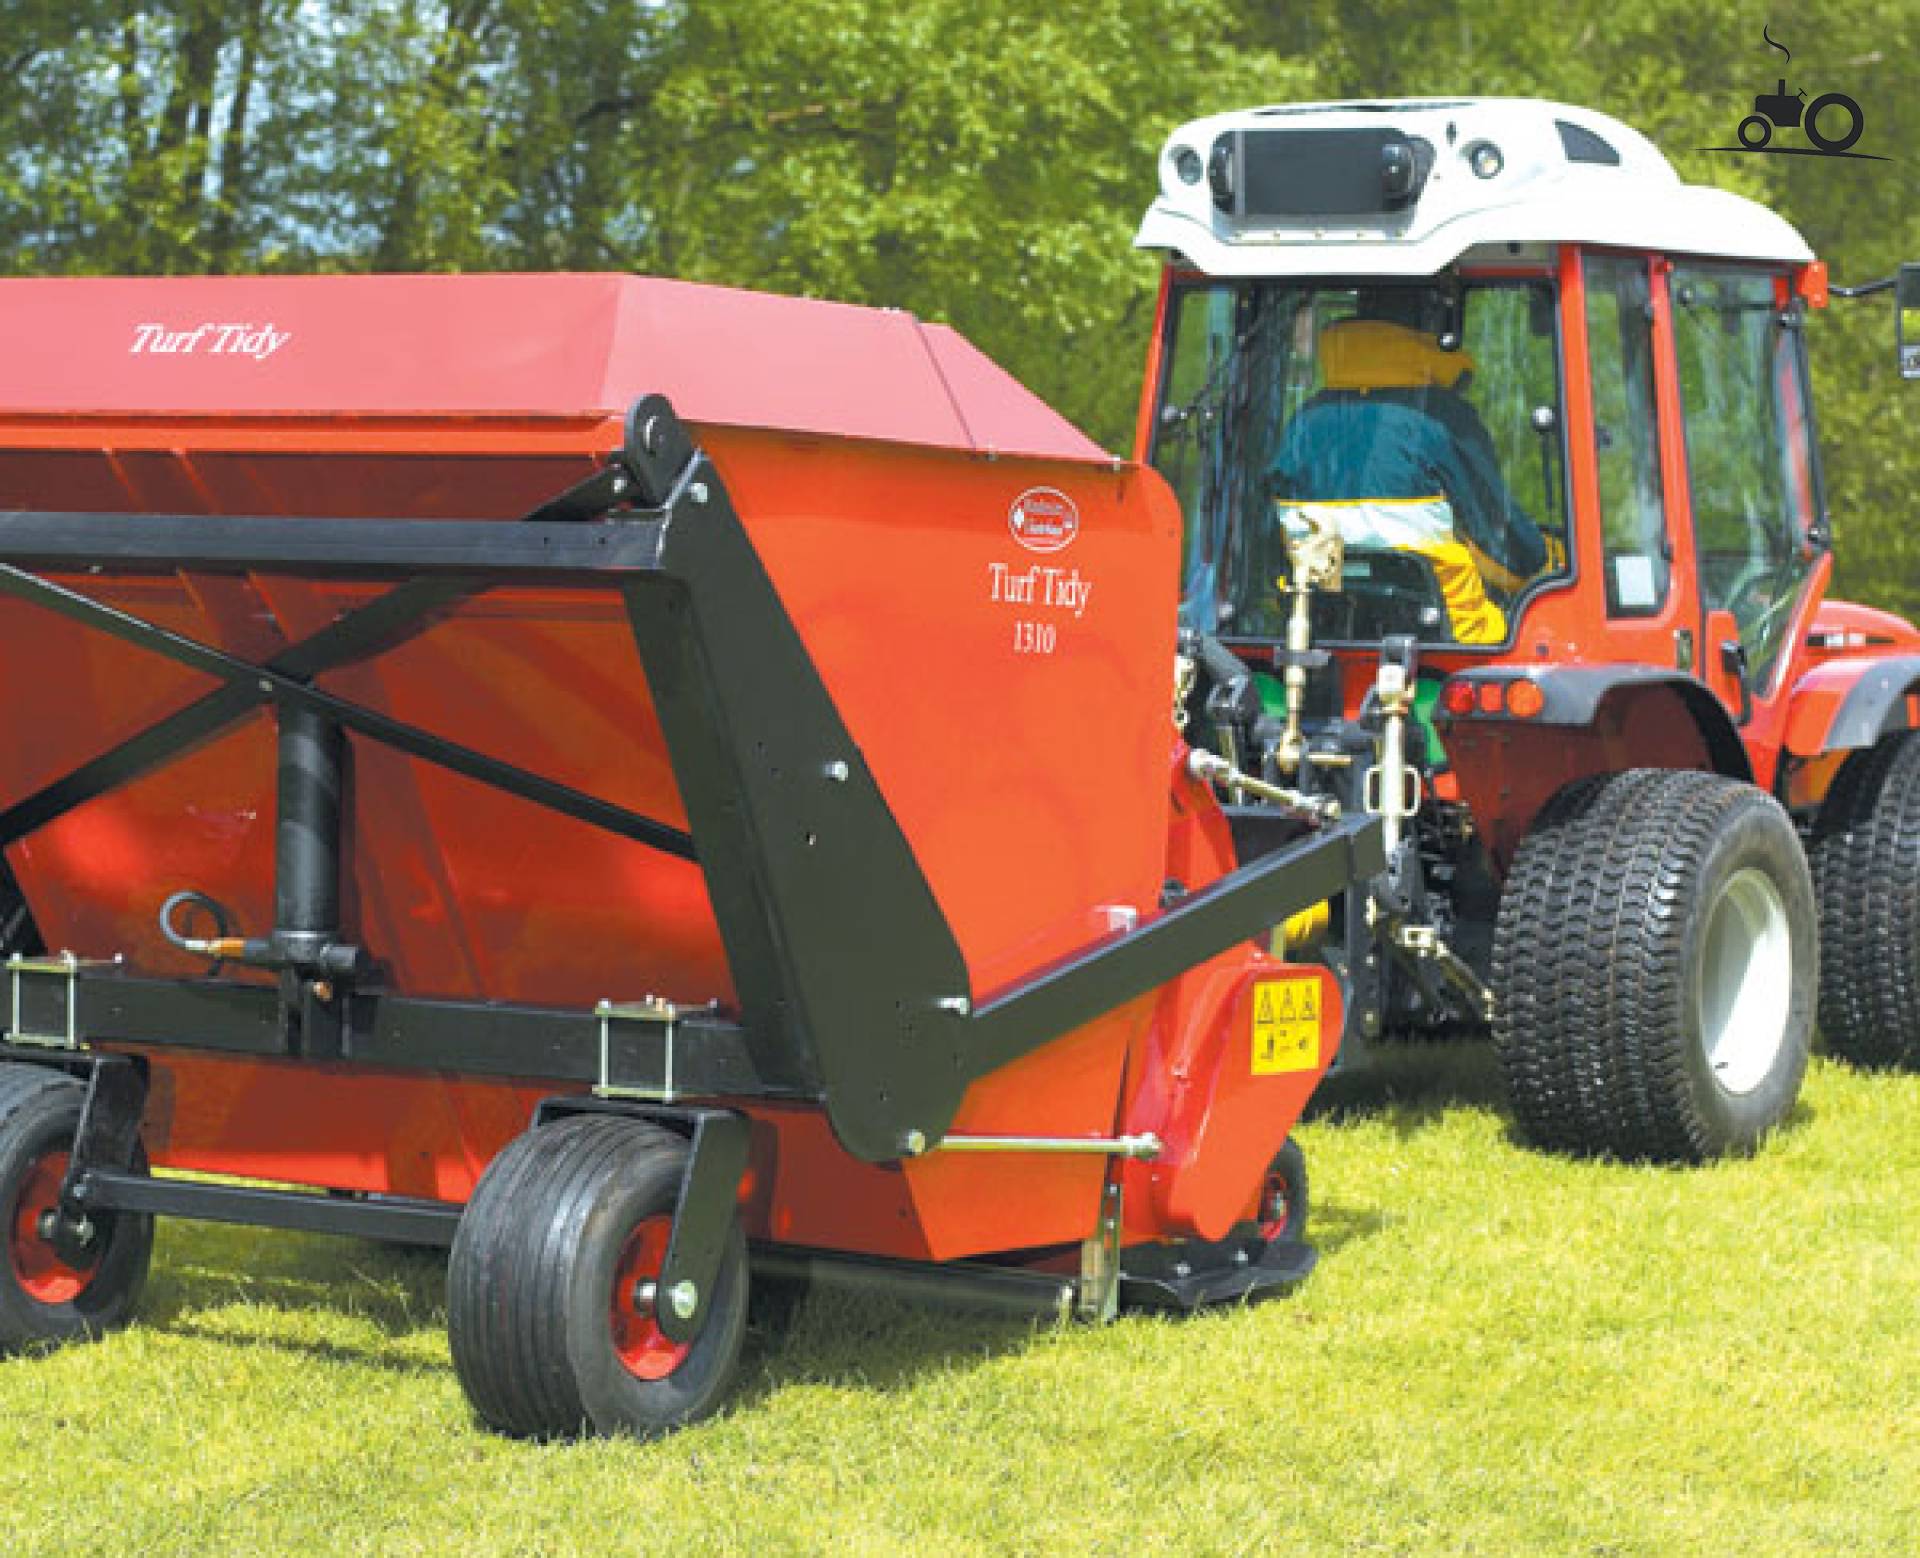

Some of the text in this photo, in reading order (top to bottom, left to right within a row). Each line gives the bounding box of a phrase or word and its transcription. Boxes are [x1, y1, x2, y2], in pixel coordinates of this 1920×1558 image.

[130, 323, 292, 361] Turf Tidy
[988, 562, 1092, 617] Turf Tidy
[1014, 620, 1057, 653] 1310
